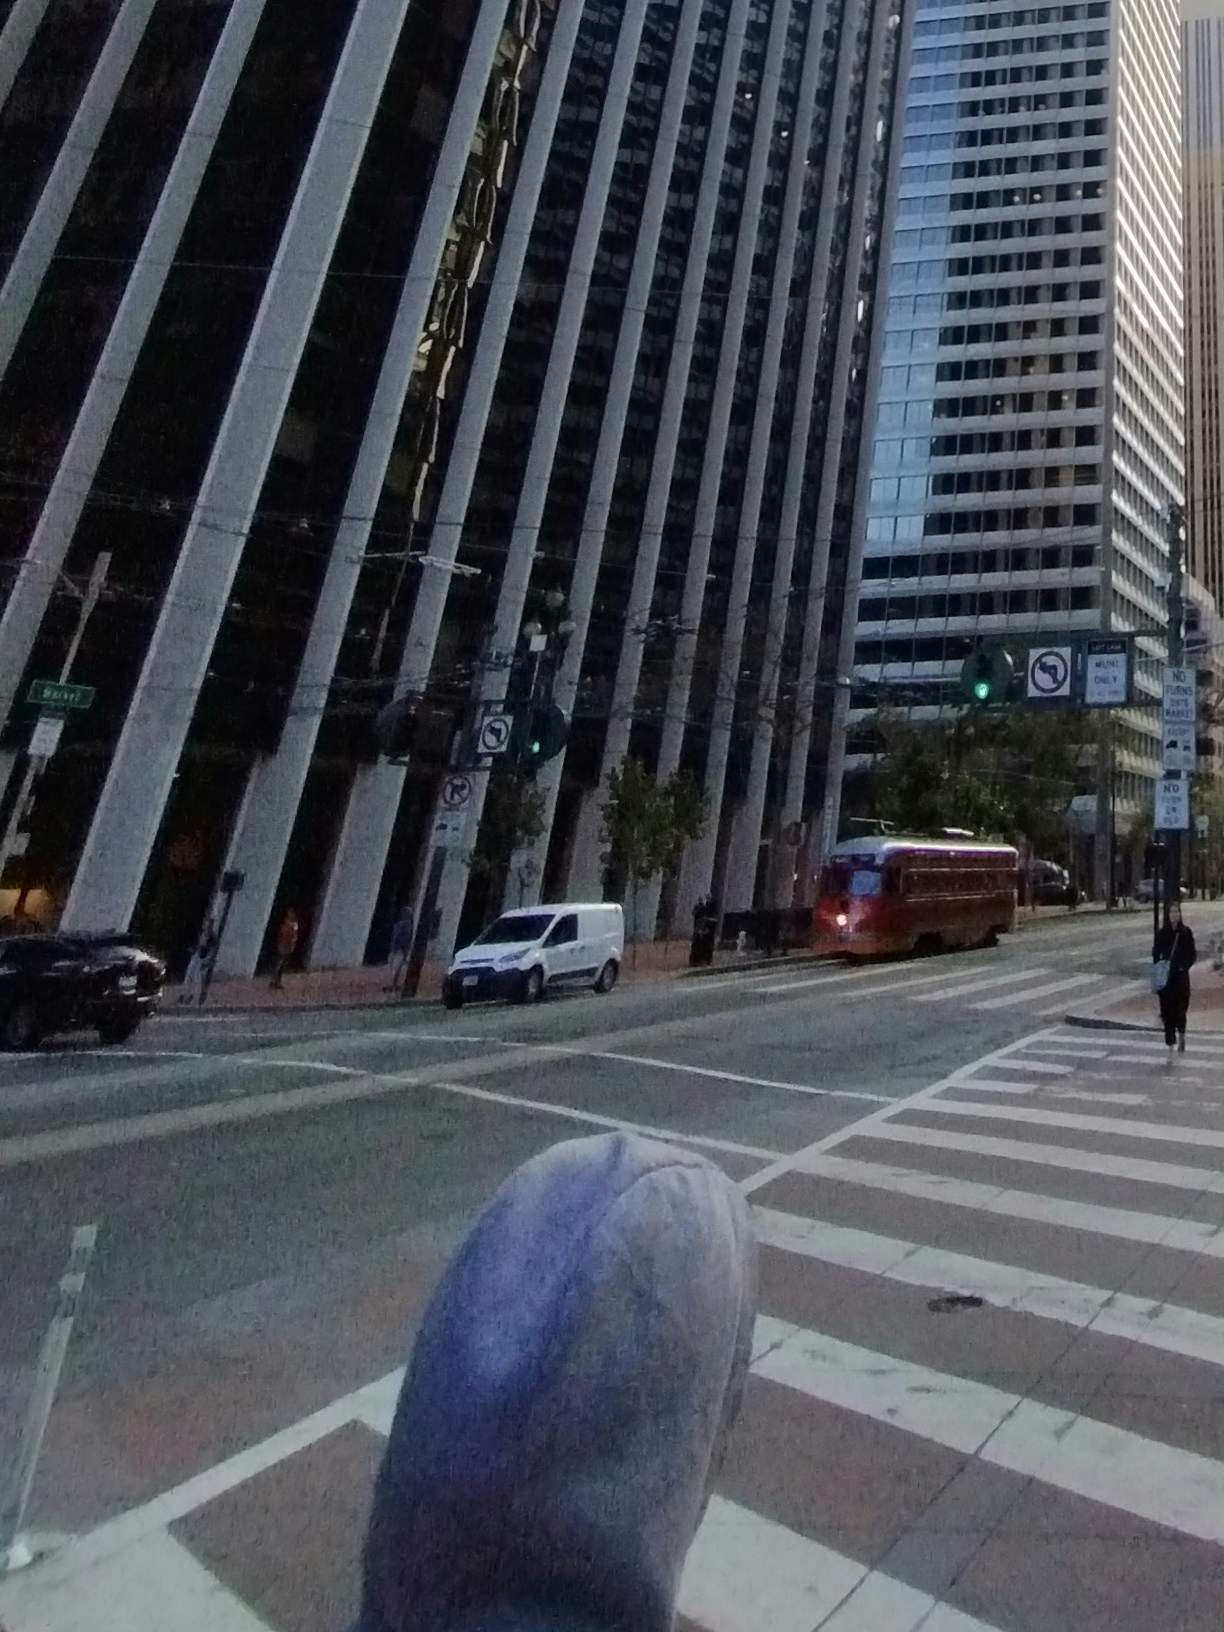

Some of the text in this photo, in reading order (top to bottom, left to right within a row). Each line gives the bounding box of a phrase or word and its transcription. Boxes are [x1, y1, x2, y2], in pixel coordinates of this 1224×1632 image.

[1094, 675, 1118, 685] ONLY
[1172, 670, 1186, 683] NO
[1163, 784, 1180, 793] NO
